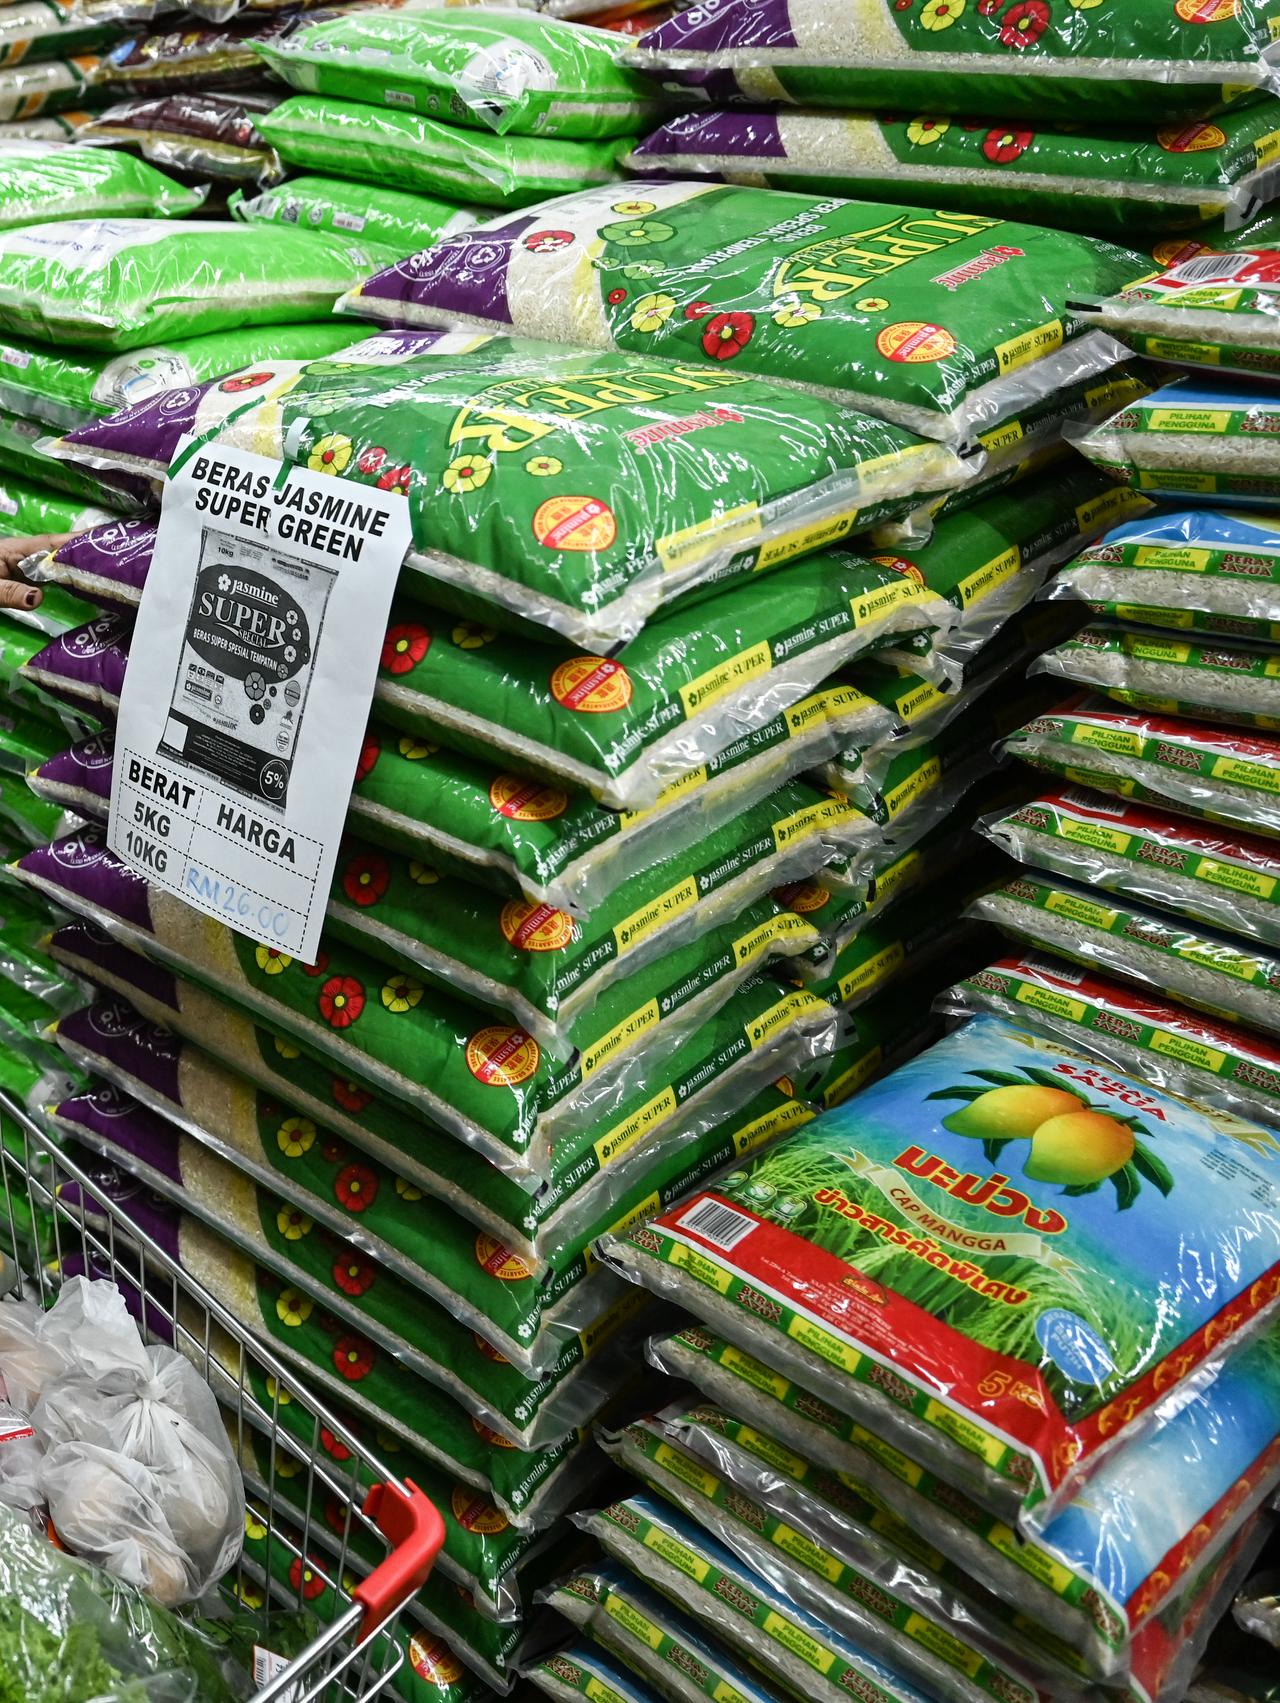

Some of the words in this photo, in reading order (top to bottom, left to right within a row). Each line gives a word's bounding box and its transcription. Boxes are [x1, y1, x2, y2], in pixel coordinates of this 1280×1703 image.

[773, 210, 1006, 301] SUPER
[449, 364, 751, 453] SUPER
[1170, 413, 1211, 421] PILIHAN
[1158, 421, 1216, 429] PENGGUNA
[191, 457, 271, 499] BERAS
[273, 483, 390, 537] JASMINE
[195, 487, 272, 533] SUPER
[278, 514, 364, 563] GREEN
[218, 546, 234, 558] 10kg
[1144, 558, 1196, 567] PENGGUNA
[1223, 554, 1273, 566] BERAS
[1219, 563, 1272, 577] SAZUA
[198, 591, 286, 646] SUPER
[193, 628, 210, 643] BERAS
[211, 633, 228, 649] SUPER
[228, 639, 249, 659] SPESIAL
[250, 648, 278, 671] TEMPATAN
[733, 652, 766, 678] SUPER
[819, 611, 850, 632] SUPER
[1081, 737, 1136, 751] PENGGUNA
[1092, 730, 1131, 743] PILIHAN
[1157, 743, 1204, 760] BERAS
[1154, 751, 1200, 770] SAZUA
[1233, 763, 1276, 778] PILIHAN
[264, 770, 284, 789] 5%
[579, 814, 616, 842] SUPER
[752, 722, 784, 746] SUPER
[128, 759, 196, 810] BERAT
[216, 803, 295, 864] HARGA
[133, 800, 171, 837] 5KG
[126, 830, 168, 872] 10KG
[1136, 849, 1185, 870] SAZUA
[1141, 841, 1189, 862] BERAS
[1205, 871, 1262, 893] PENGGUNA
[1216, 865, 1257, 883] PILIHAN
[582, 941, 613, 971] SUPER
[663, 886, 693, 912] SUPER
[742, 837, 772, 863] SUPER
[1053, 902, 1104, 925] PENGGUNA
[1024, 994, 1074, 1017] PENGGUNA
[1034, 989, 1071, 1007] PILIHAN
[547, 1070, 578, 1099] SUPER
[626, 1009, 655, 1034] SUPER
[703, 955, 731, 979] SUPER
[1092, 1019, 1140, 1041] SAZUA
[1098, 1011, 1143, 1033] BERAS
[1157, 1042, 1211, 1067] PENGGUNA
[1168, 1037, 1208, 1057] PILIHAN
[1052, 1063, 1168, 1121] SAZUA
[1084, 1069, 1156, 1104] BERAS
[564, 1158, 596, 1186] SUPER
[643, 1097, 671, 1124] SUPER
[718, 1039, 746, 1065] SUPER
[702, 1147, 731, 1172] SUPER
[892, 1145, 1068, 1235] มะม่วง
[889, 1187, 920, 1212] CAP
[919, 1214, 1006, 1251] MANGGA
[554, 1264, 583, 1293] SUPER
[736, 1293, 781, 1324] SAZUA
[740, 1284, 784, 1316] BERAS
[795, 1330, 848, 1368] PENGGUNA
[807, 1318, 844, 1351] PILIHAN
[977, 1370, 1012, 1399] 5
[652, 1540, 698, 1577] PENGGUNA
[661, 1536, 695, 1565] PILIHAN
[714, 1582, 755, 1619] SAZUA
[719, 1575, 759, 1609] BERAS
[610, 1607, 652, 1644] PENGGUNA
[782, 1623, 818, 1654] PILIHAN
[671, 1646, 708, 1677] BERAS
[772, 1627, 822, 1666] PENGGUNA
